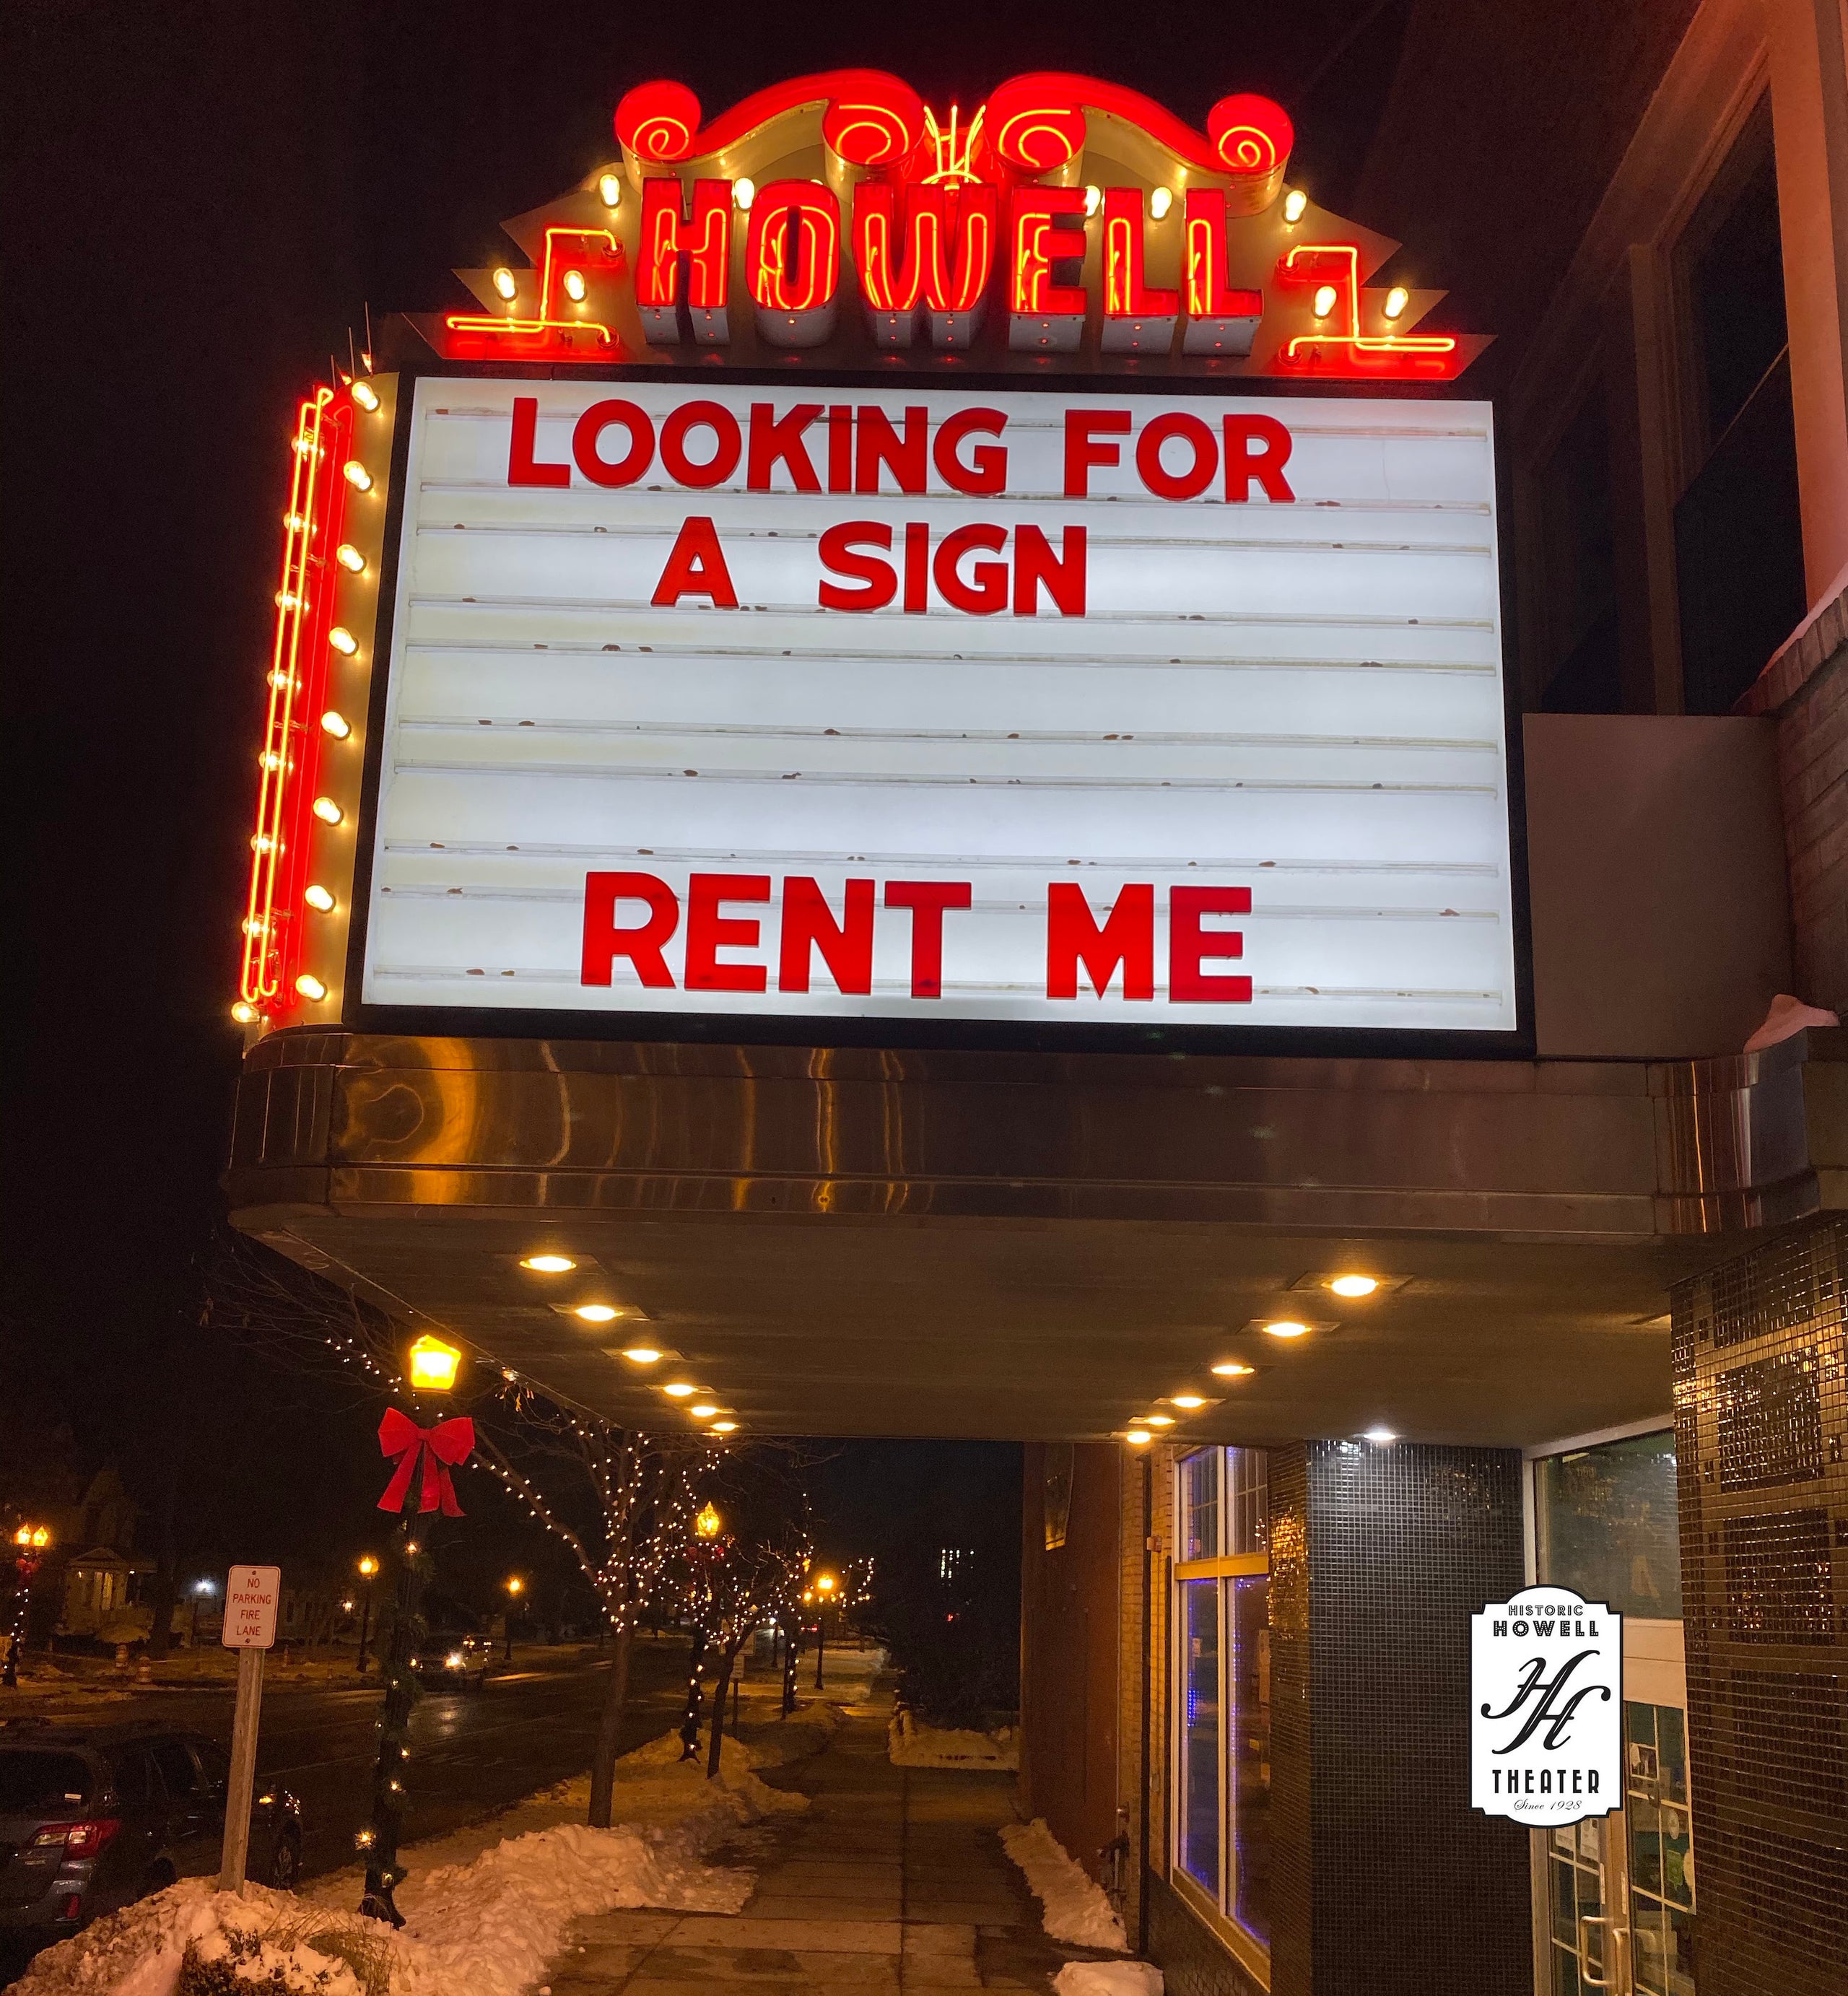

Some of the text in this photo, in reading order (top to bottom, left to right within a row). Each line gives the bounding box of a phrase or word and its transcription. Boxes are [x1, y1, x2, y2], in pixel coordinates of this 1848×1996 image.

[635, 177, 1264, 316] HOWELL
[509, 397, 1294, 502] LOOKING FOR
[653, 517, 1086, 616] A SIGN
[582, 872, 1252, 1003] RENT ME
[232, 1593, 271, 1604] PARKING
[247, 1578, 260, 1588] NO
[236, 1625, 261, 1636] LANE
[240, 1610, 261, 1620] FIRE
